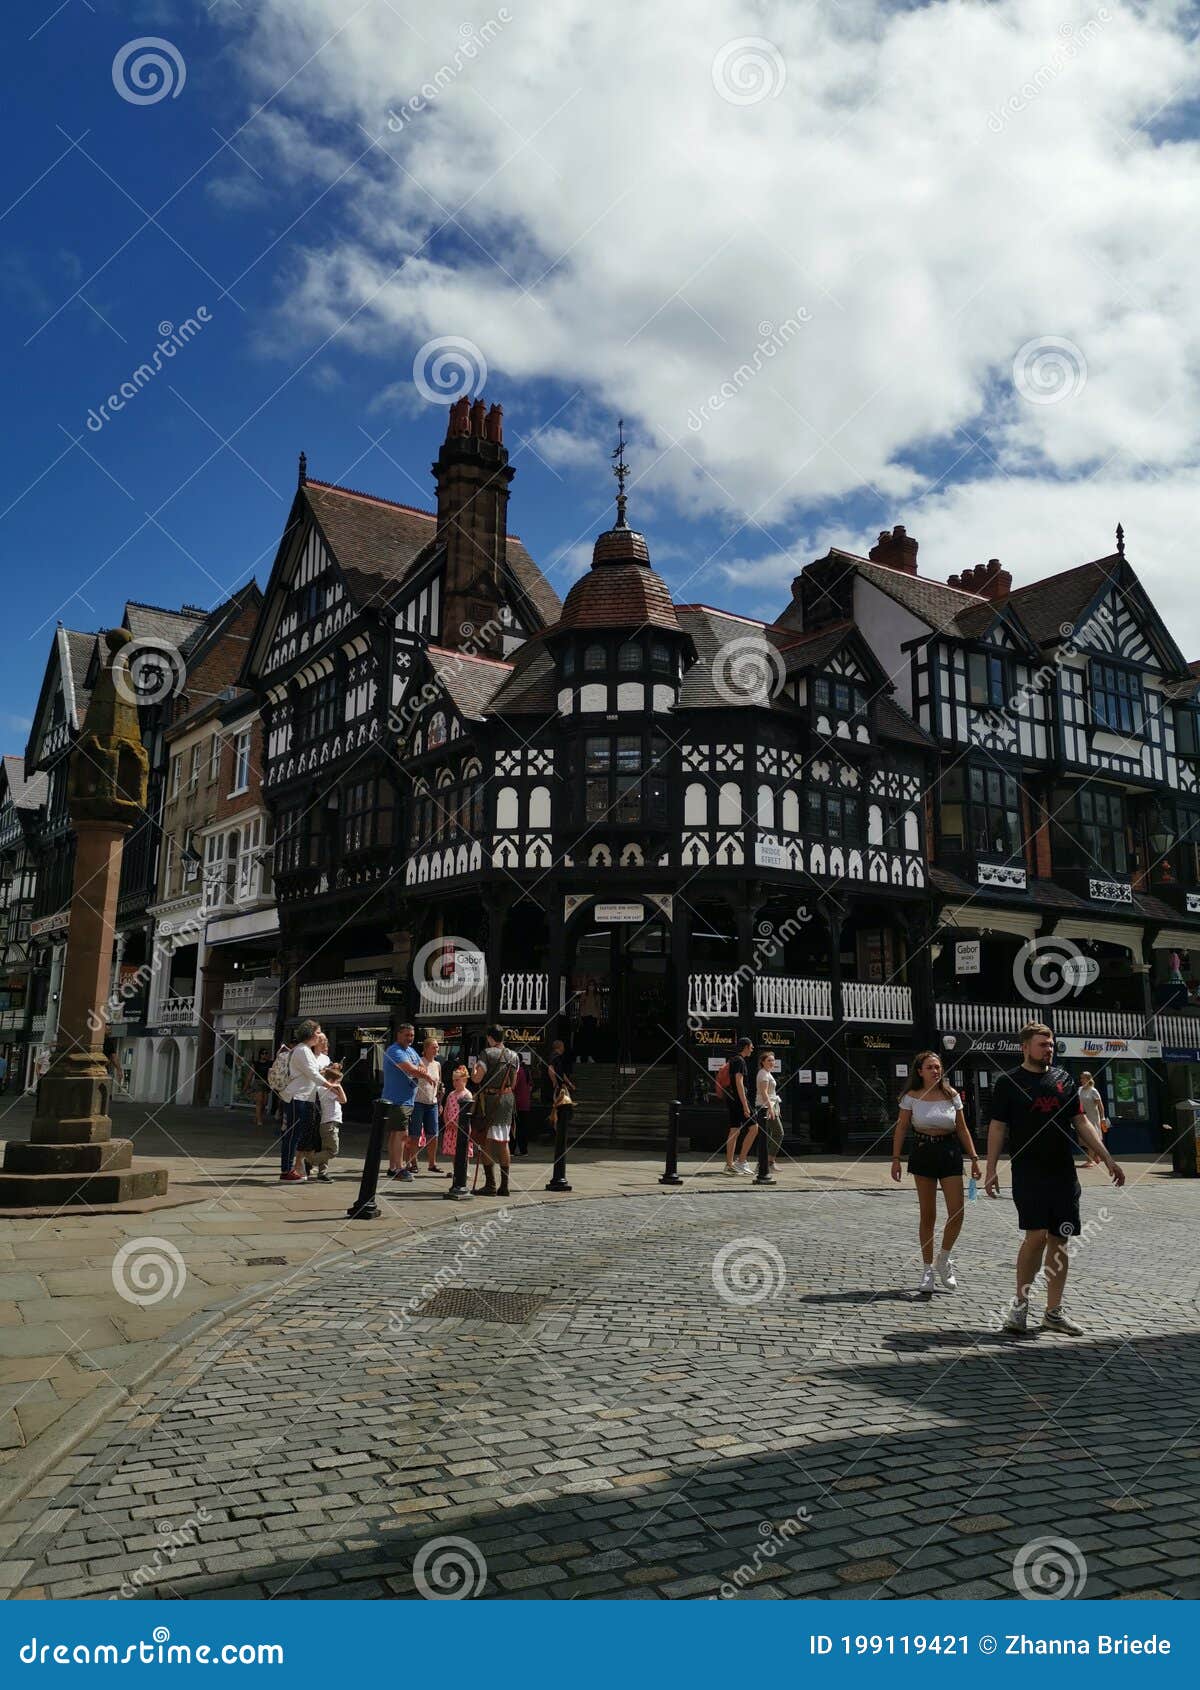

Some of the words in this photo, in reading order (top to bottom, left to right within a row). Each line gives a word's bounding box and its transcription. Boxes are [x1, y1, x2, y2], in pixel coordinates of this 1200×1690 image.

[761, 856, 781, 865] STREET
[957, 945, 979, 954] Gabor
[457, 954, 483, 965] Gabor
[694, 1031, 733, 1044] Waltons
[970, 1040, 995, 1051] Lotus
[997, 1040, 1024, 1051] Diam
